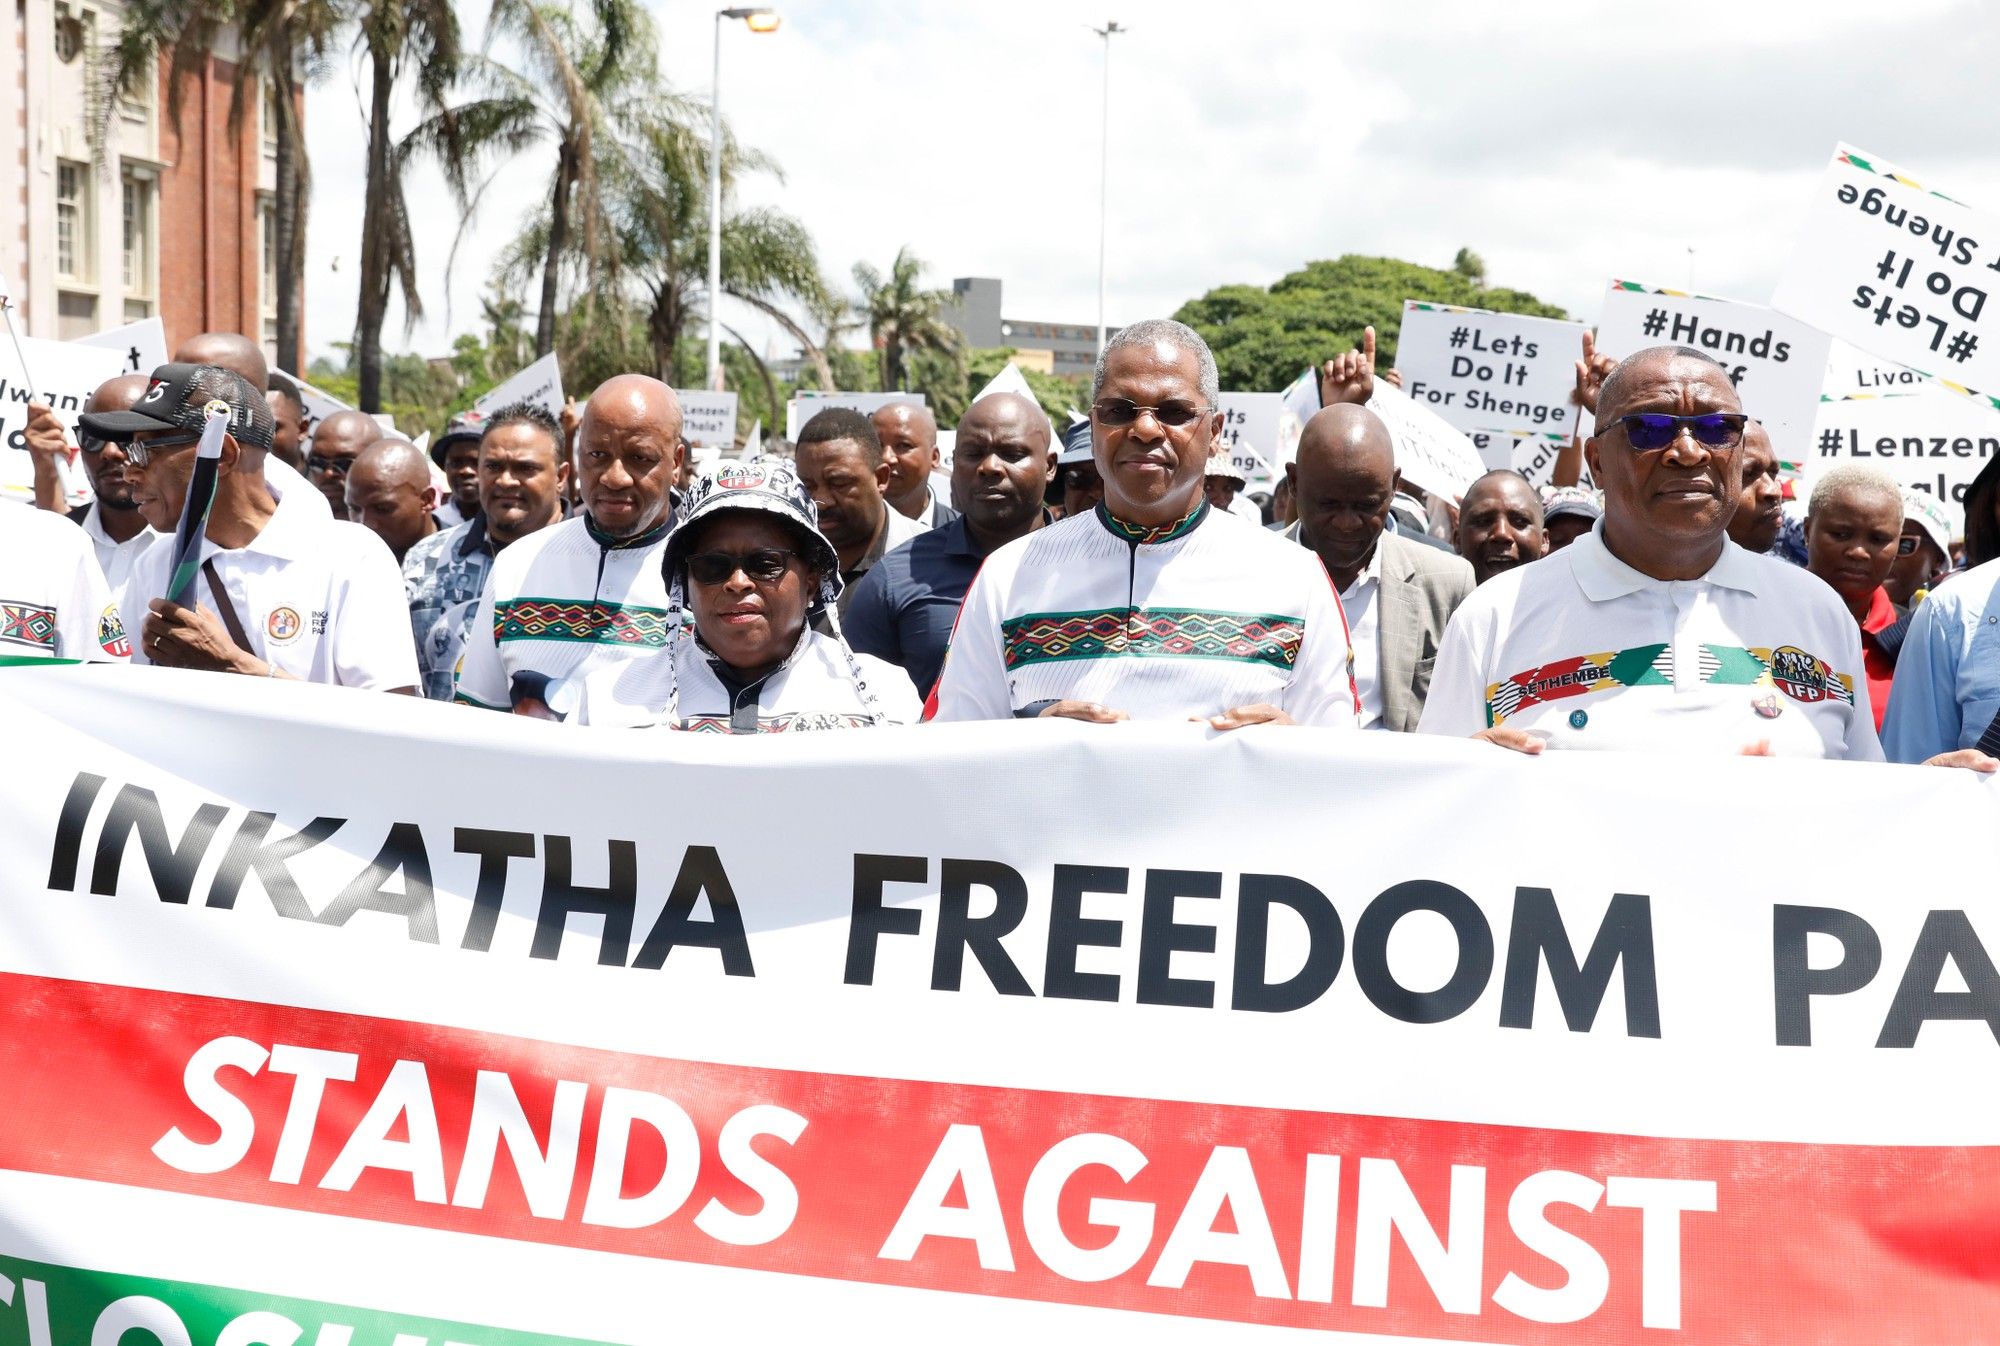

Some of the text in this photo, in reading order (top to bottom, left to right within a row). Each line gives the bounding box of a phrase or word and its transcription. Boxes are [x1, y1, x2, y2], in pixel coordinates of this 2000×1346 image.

[1837, 183, 1979, 266] Shenge
[1876, 249, 1988, 323] Do It
[1450, 326, 1539, 359] #Lets
[1643, 308, 1791, 362] #Hands
[1852, 285, 1979, 364] #Lets
[1451, 356, 1528, 387] Do It
[1857, 368, 1923, 387] Liva
[1411, 381, 1566, 424] For Shenge
[1786, 682, 1819, 700] IFP
[47, 770, 2000, 1049] INKATHA FREEDOM PA
[150, 1035, 1718, 1330] STANDS AGAINST
